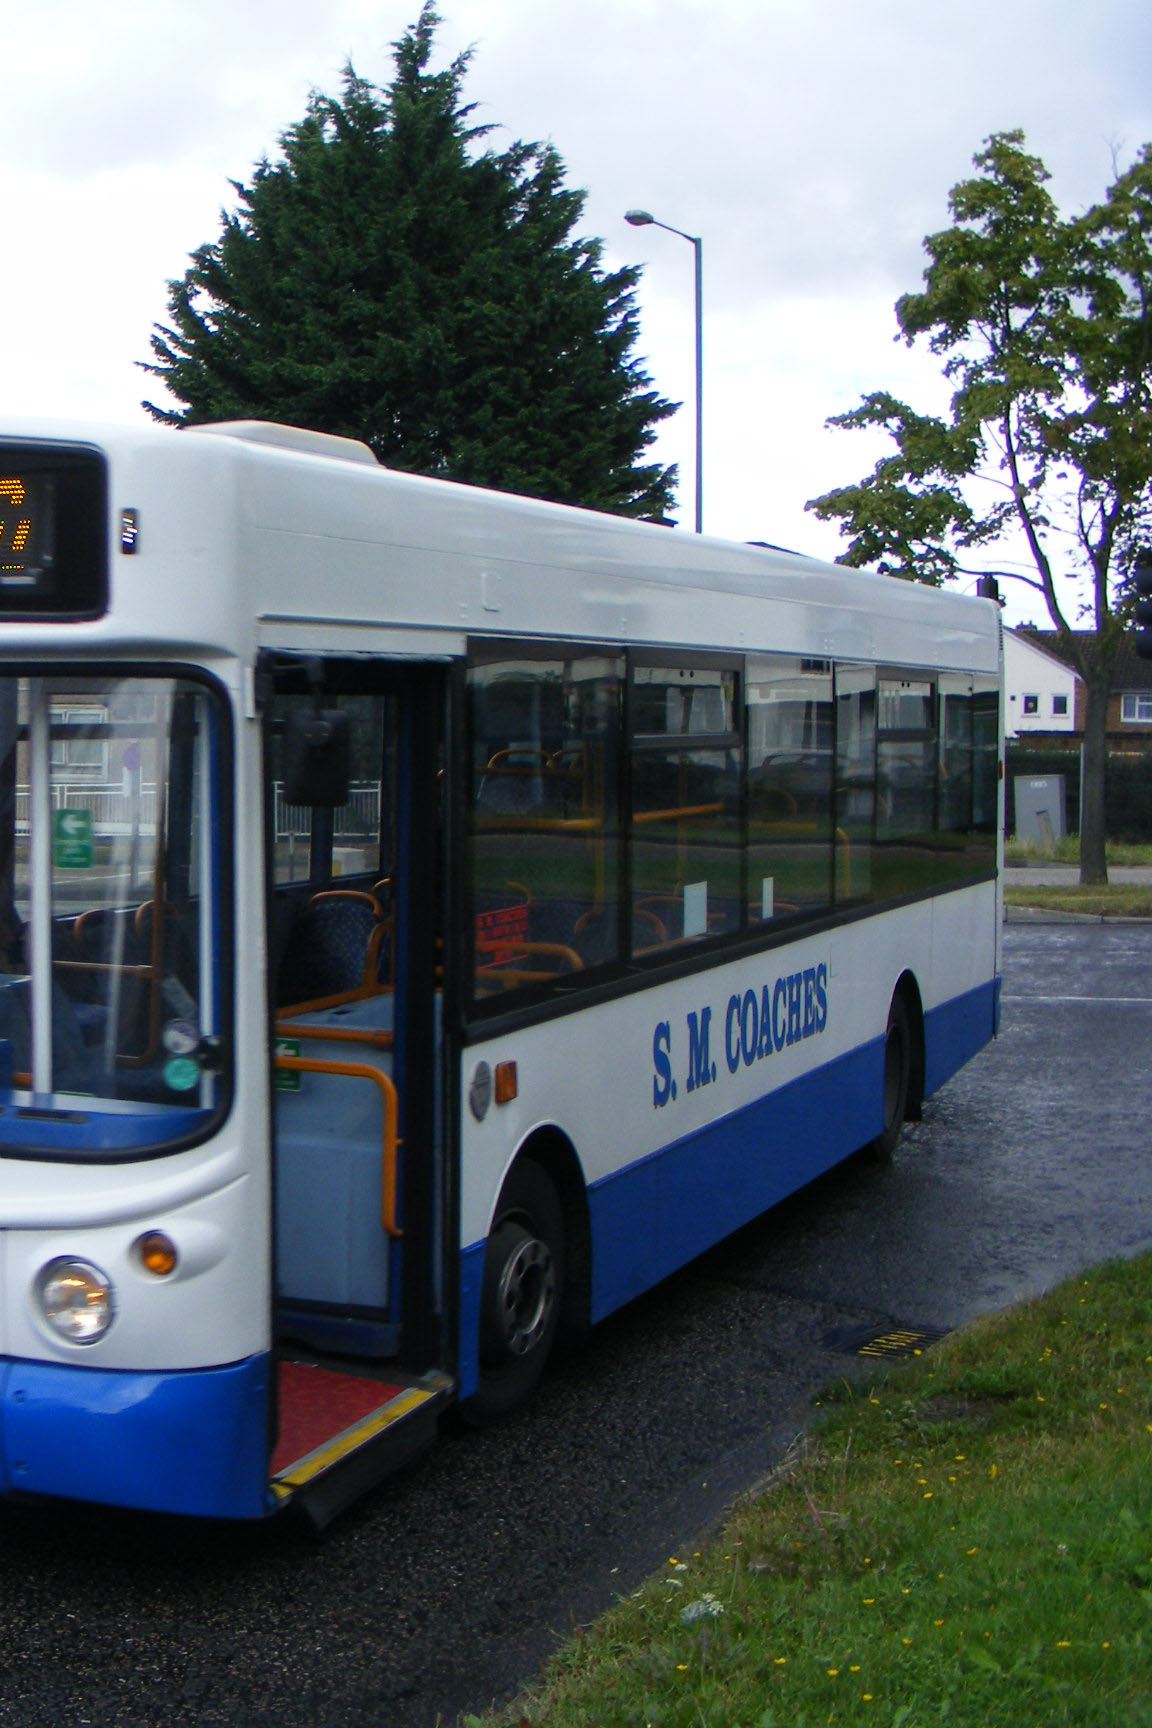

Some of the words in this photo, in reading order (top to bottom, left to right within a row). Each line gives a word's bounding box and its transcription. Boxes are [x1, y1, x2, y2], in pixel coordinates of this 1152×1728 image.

[652, 1020, 678, 1109] S.
[686, 1006, 717, 1093] M.
[725, 962, 828, 1074] COACHES
